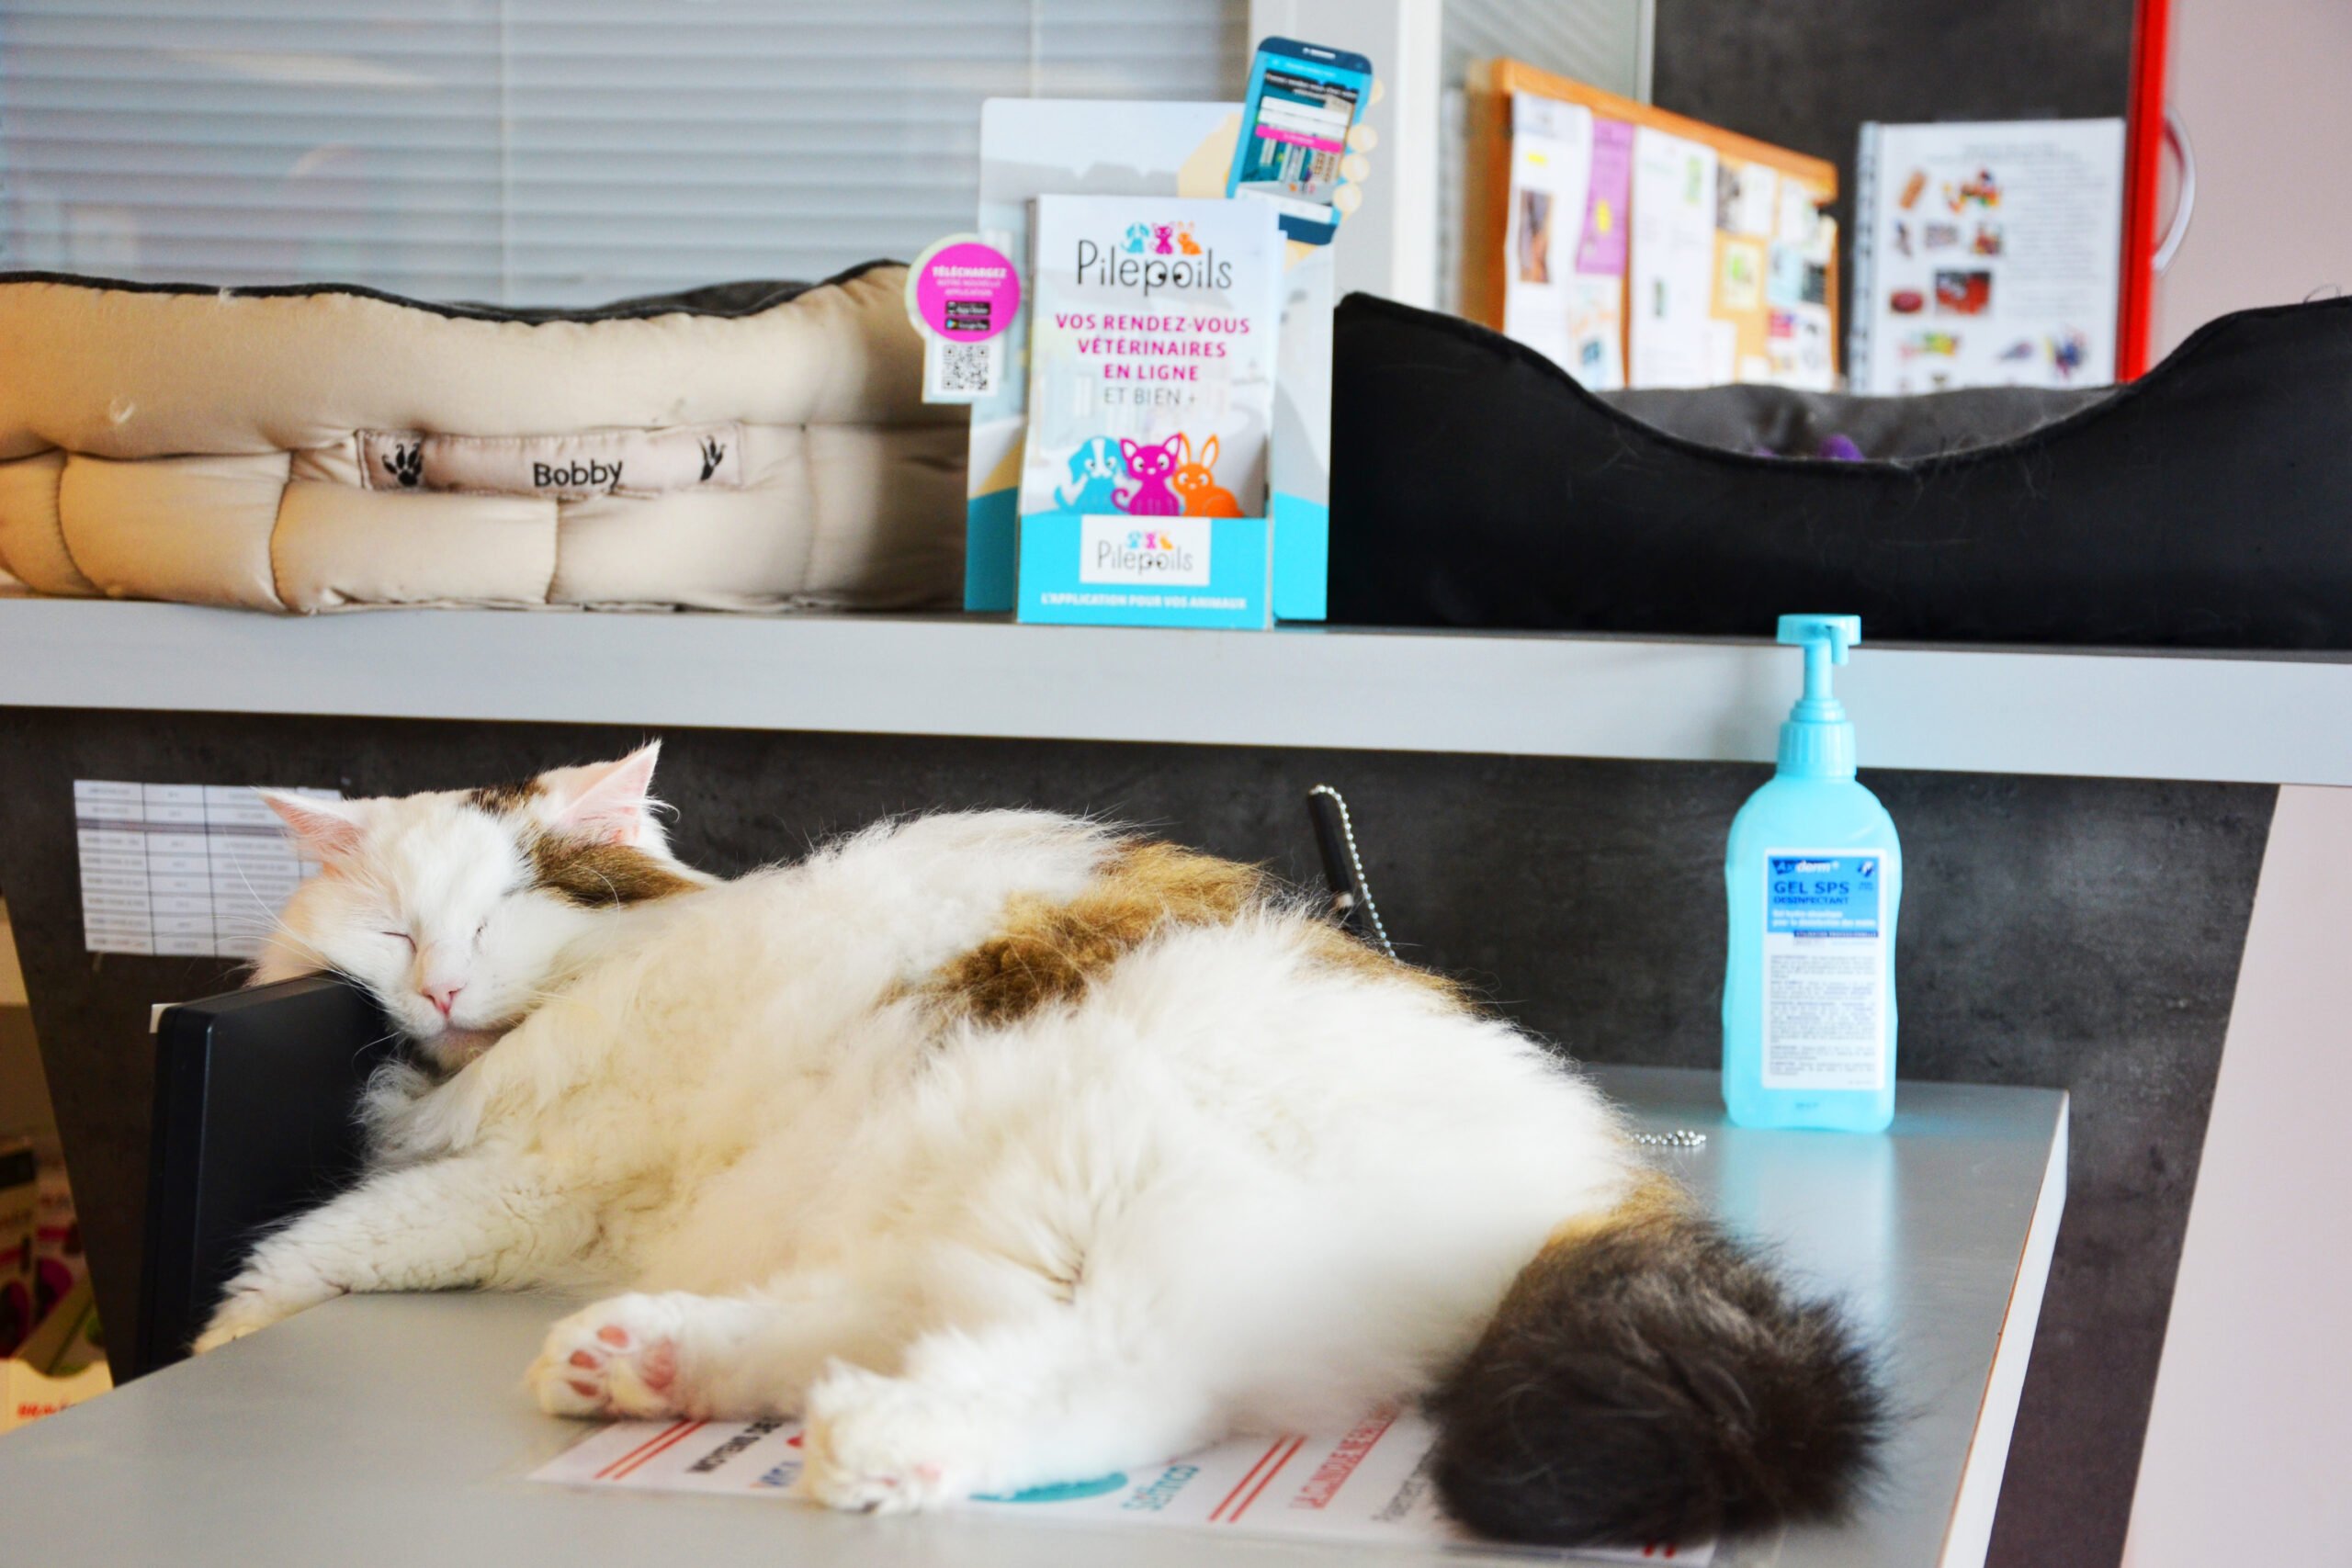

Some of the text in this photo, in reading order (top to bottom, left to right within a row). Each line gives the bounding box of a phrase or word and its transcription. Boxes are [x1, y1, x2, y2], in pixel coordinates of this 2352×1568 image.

[1077, 239, 1232, 297] Pilepoils
[1056, 313, 1250, 333] VOS RENDEZ-VOUS
[1078, 337, 1227, 357] VÉTÉRINAIRES
[1104, 364, 1199, 381] EN LIGNE
[1104, 387, 1127, 403] ET
[1135, 388, 1181, 404] BIEN
[534, 458, 622, 493] Bobby
[1097, 539, 1193, 575] Pilepoils
[1041, 592, 1127, 606] L'APPLICATION
[1129, 594, 1162, 607] POUR
[1164, 596, 1188, 608] VOS
[1774, 881, 1808, 894] GEL
[1815, 881, 1849, 894] SPS
